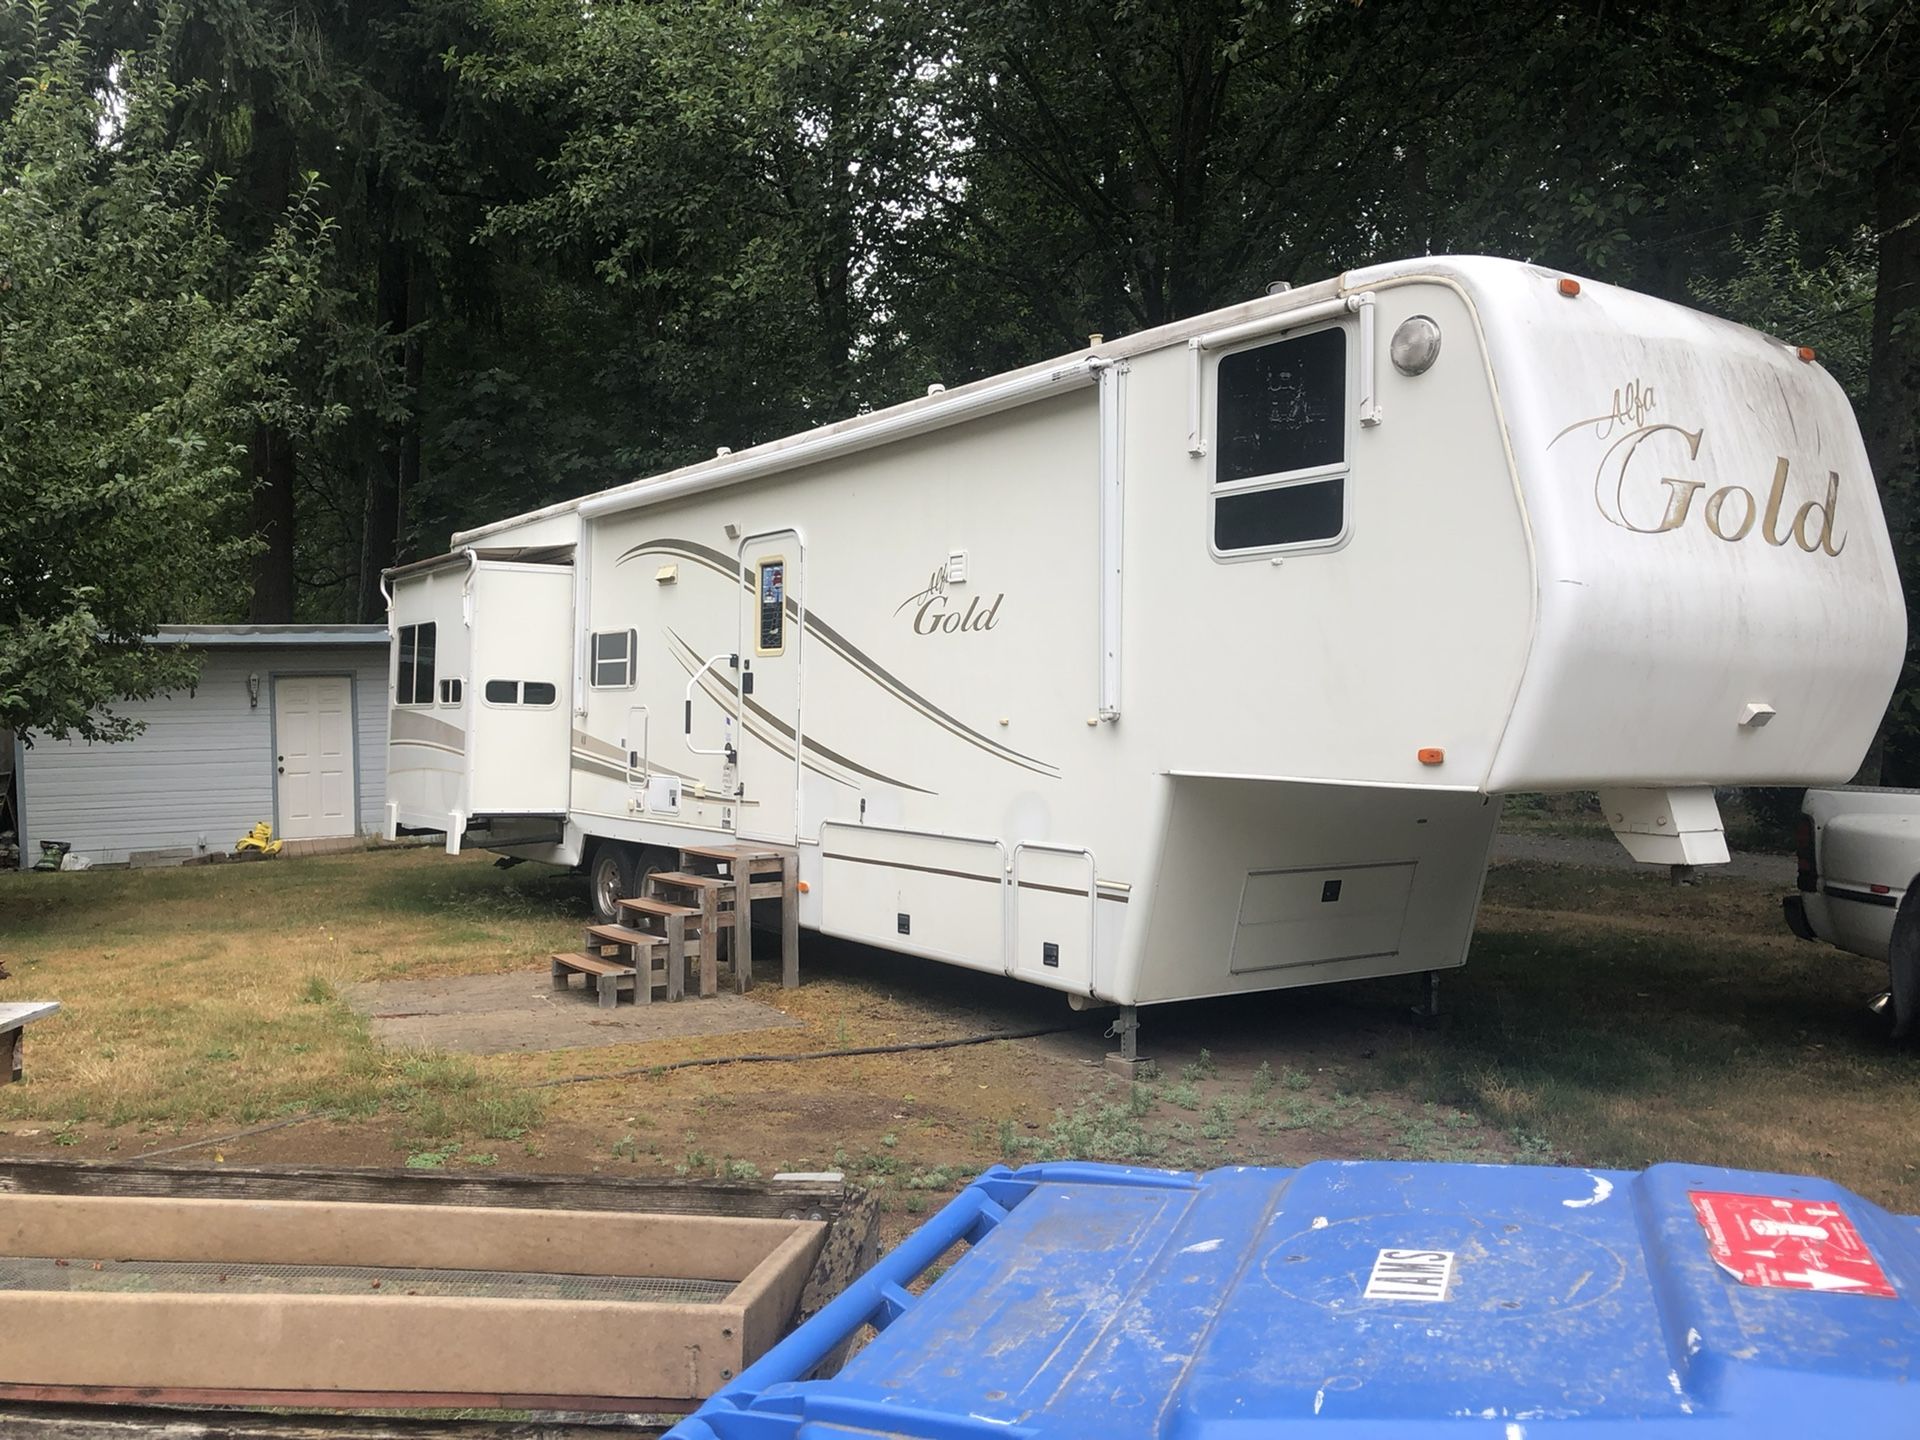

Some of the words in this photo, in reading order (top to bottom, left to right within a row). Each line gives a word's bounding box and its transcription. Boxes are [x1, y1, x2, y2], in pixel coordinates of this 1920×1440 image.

[1596, 377, 1656, 440] Alfa
[1594, 423, 1847, 557] Gold
[913, 593, 1005, 636] Gold
